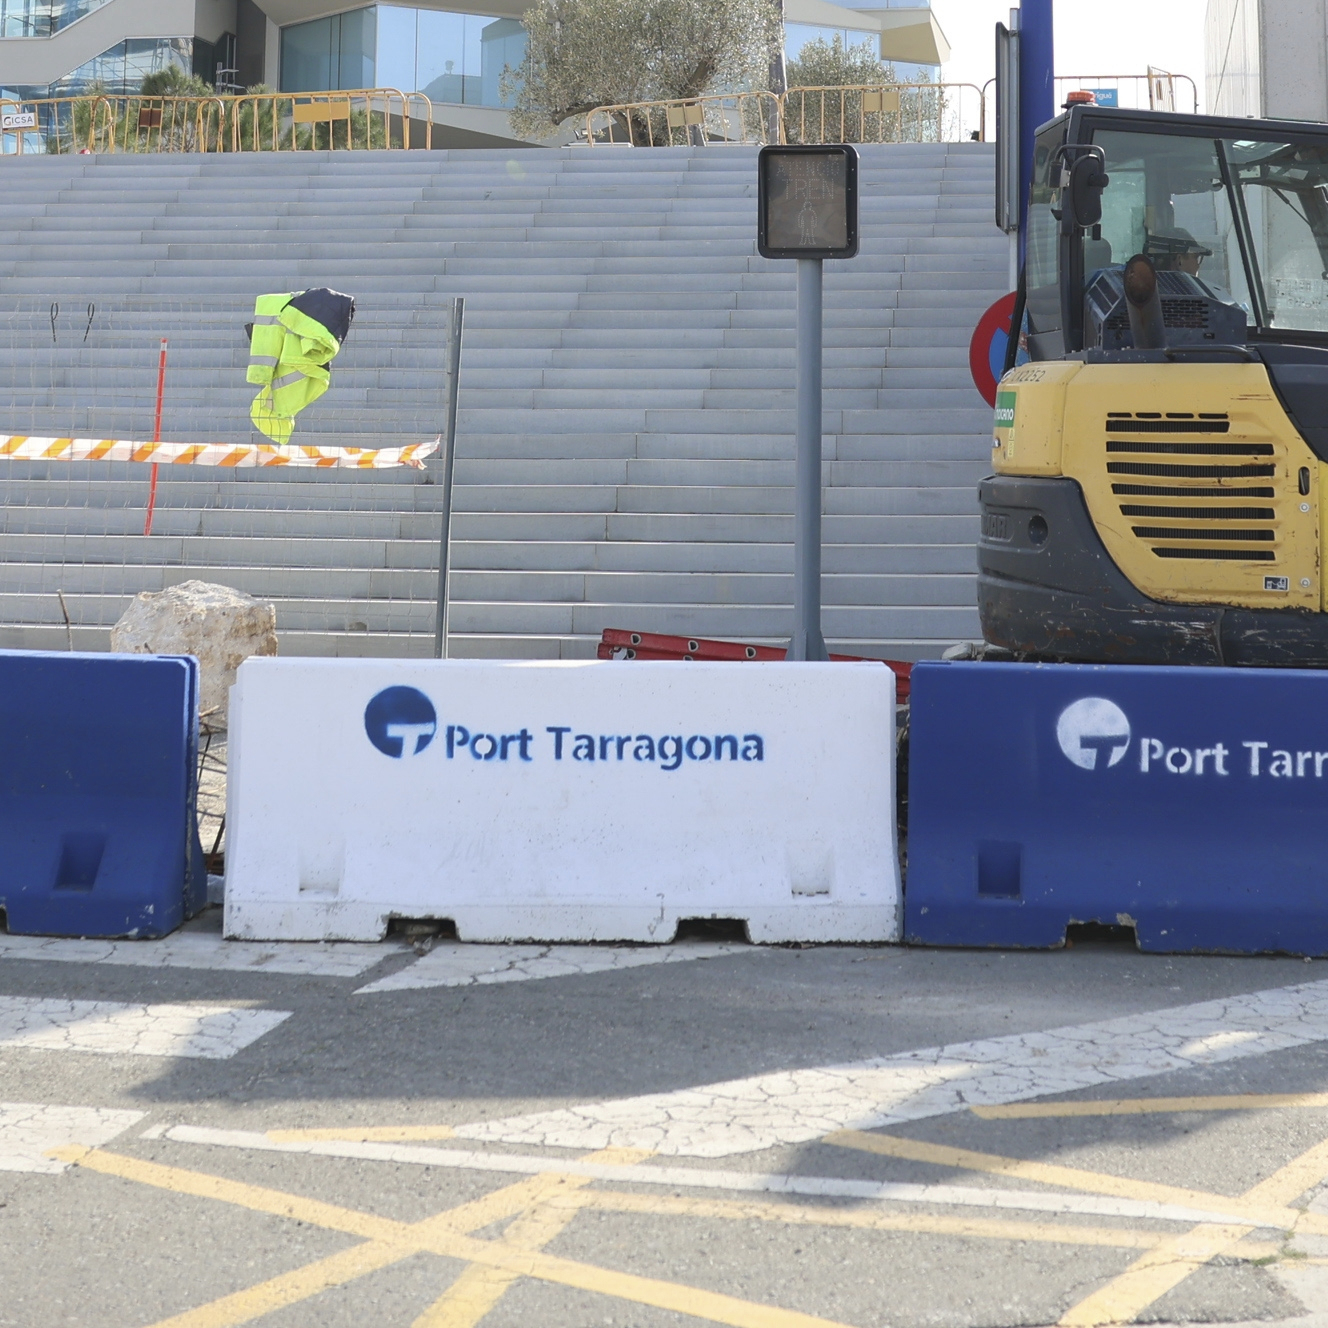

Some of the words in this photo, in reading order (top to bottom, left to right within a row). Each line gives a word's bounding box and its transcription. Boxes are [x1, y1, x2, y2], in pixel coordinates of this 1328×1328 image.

[4, 116, 33, 126] GICSA
[782, 178, 834, 200] TREN
[445, 724, 534, 762] Port
[546, 726, 764, 771] Tarragona
[1139, 738, 1230, 776] Port
